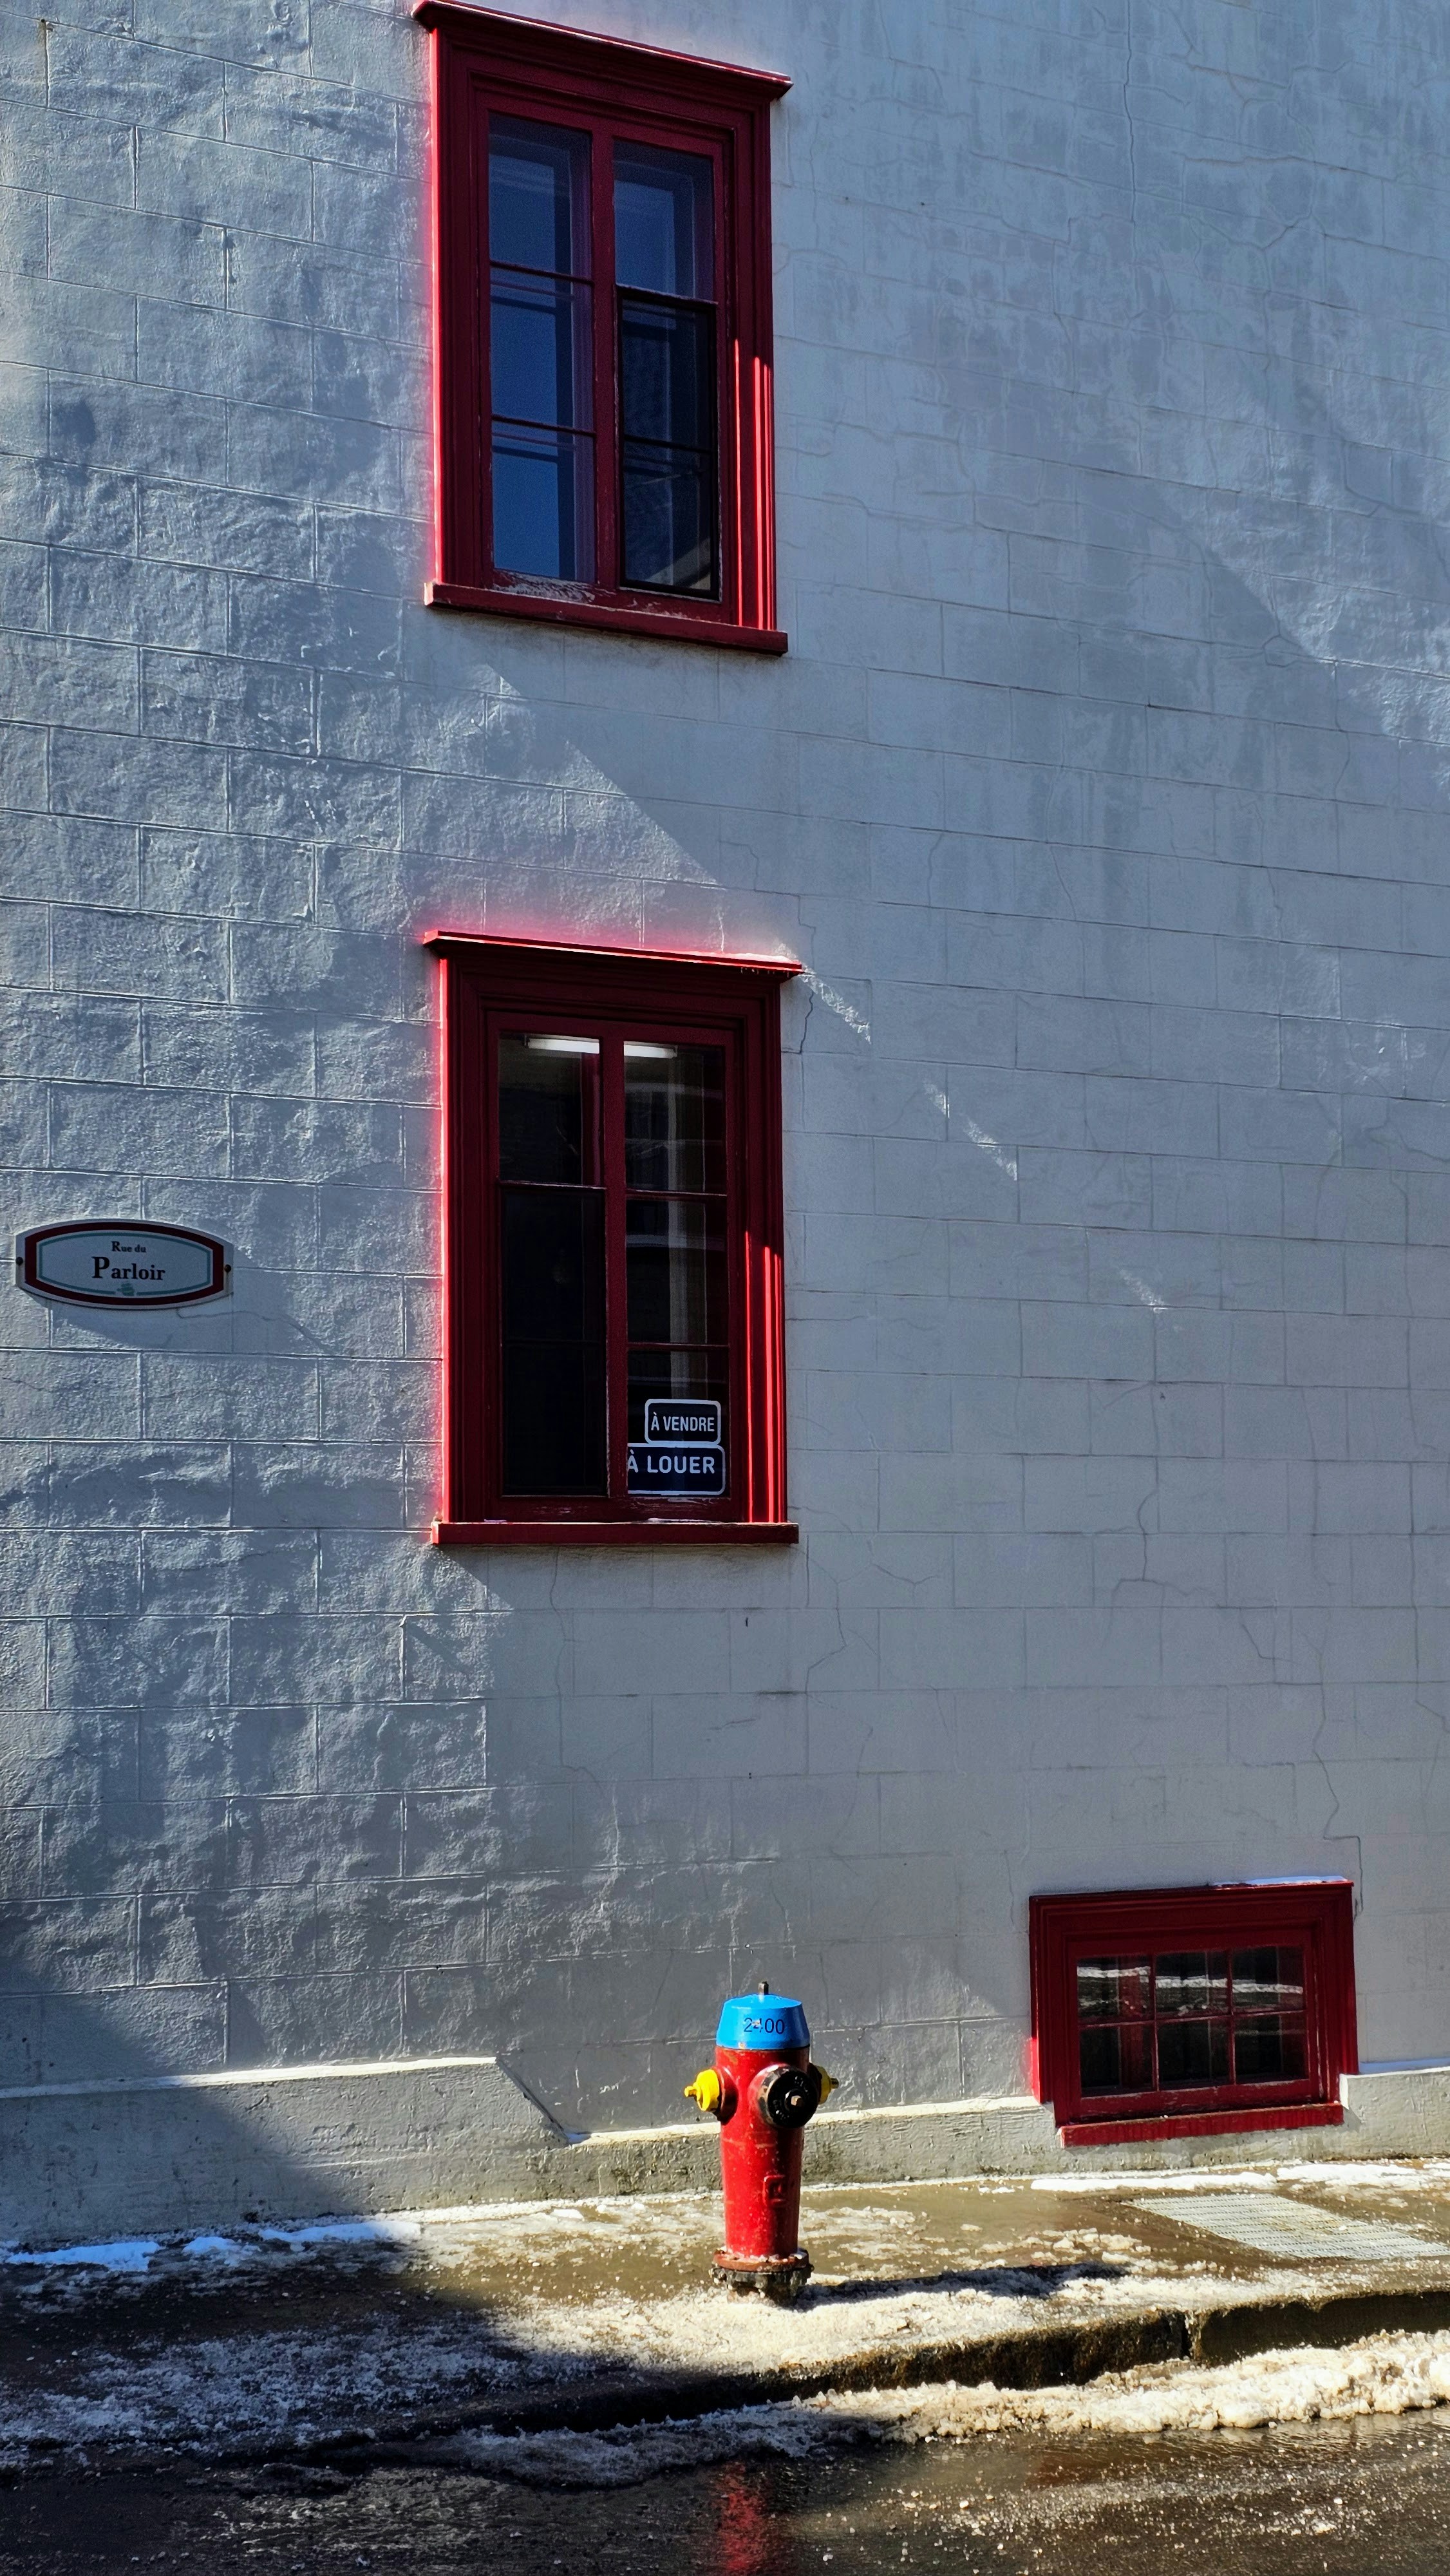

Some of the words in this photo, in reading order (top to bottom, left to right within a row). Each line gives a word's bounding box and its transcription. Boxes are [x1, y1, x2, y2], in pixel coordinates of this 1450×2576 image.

[111, 1241, 131, 1253] Rue
[134, 1244, 146, 1253] du
[91, 1256, 165, 1280] Parloir
[651, 1412, 660, 1430] À
[663, 1416, 715, 1432] VENDRE
[627, 1449, 639, 1473] À
[647, 1455, 715, 1473] LOUER
[744, 2018, 785, 2034] 2400
